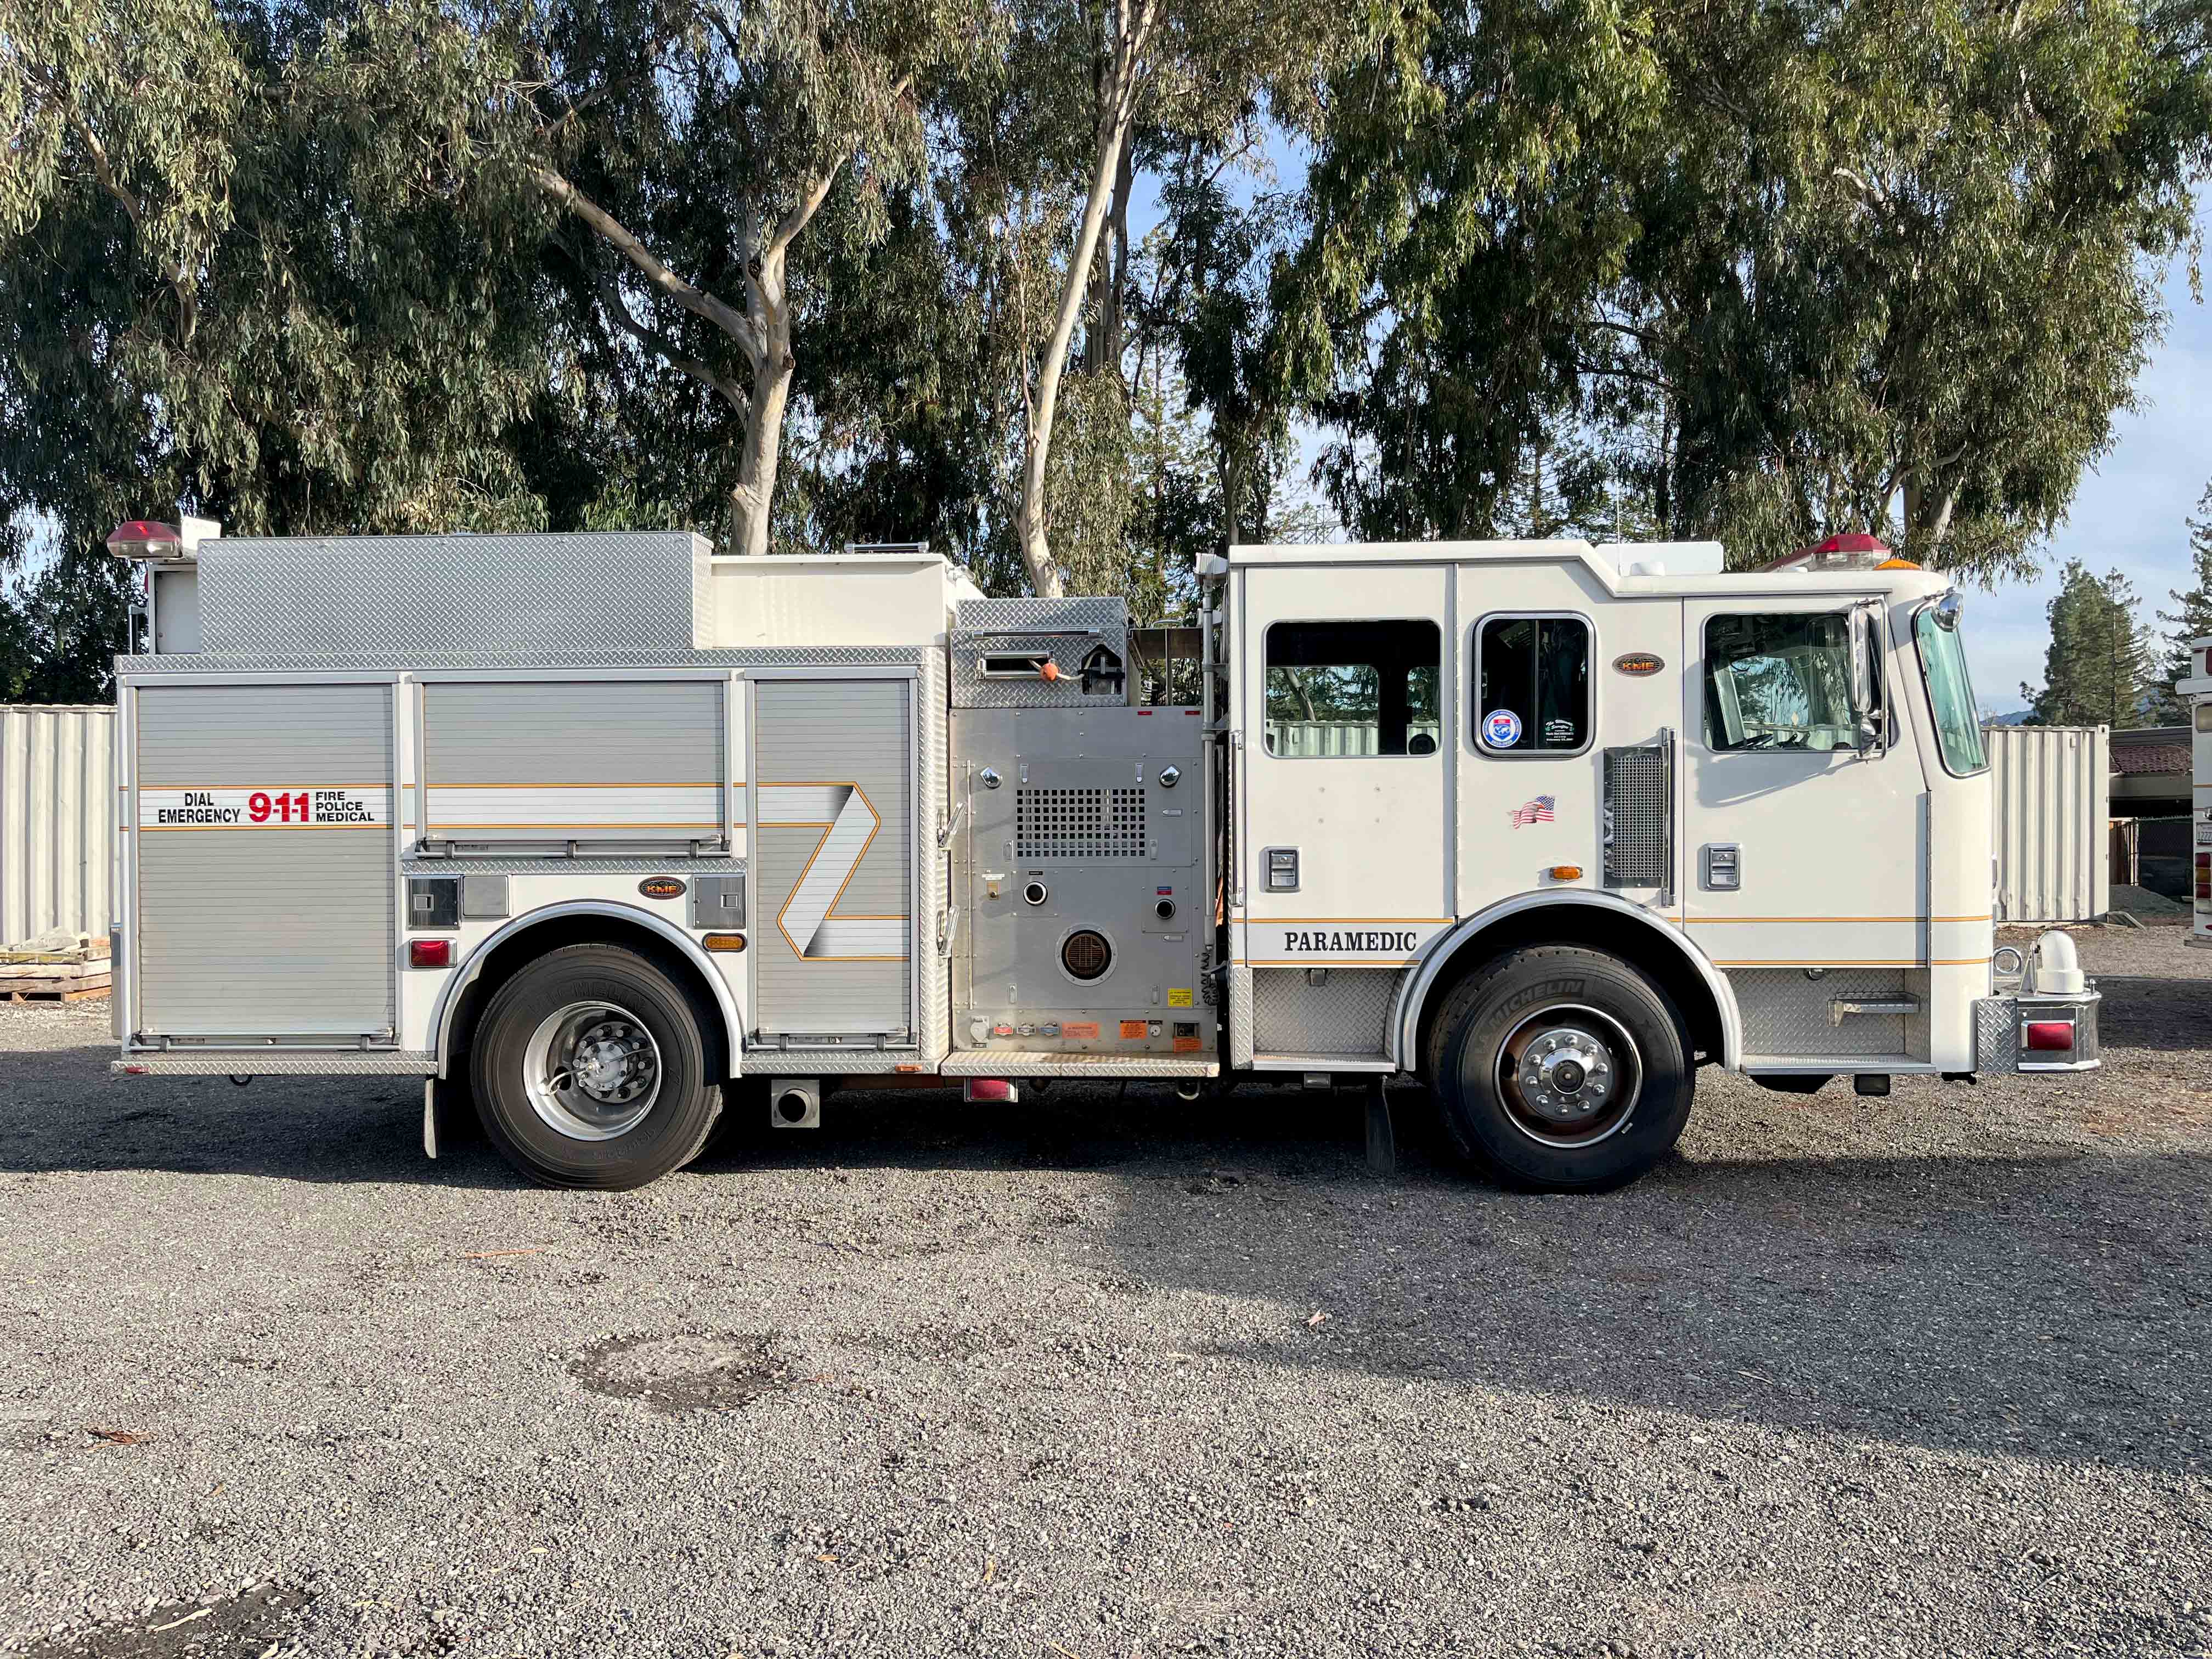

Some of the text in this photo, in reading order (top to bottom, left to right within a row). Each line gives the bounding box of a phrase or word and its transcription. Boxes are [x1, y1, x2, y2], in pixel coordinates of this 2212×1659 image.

[185, 793, 215, 806] DIAL
[315, 792, 345, 800] FIRE
[249, 793, 309, 822] 9-1-1
[316, 802, 363, 811] POLICE
[159, 809, 240, 823] EMERGENCY
[316, 812, 375, 822] MEDICAL
[1284, 932, 1417, 951] PARAMEDIC
[1488, 980, 1584, 1028] MICHELIN
